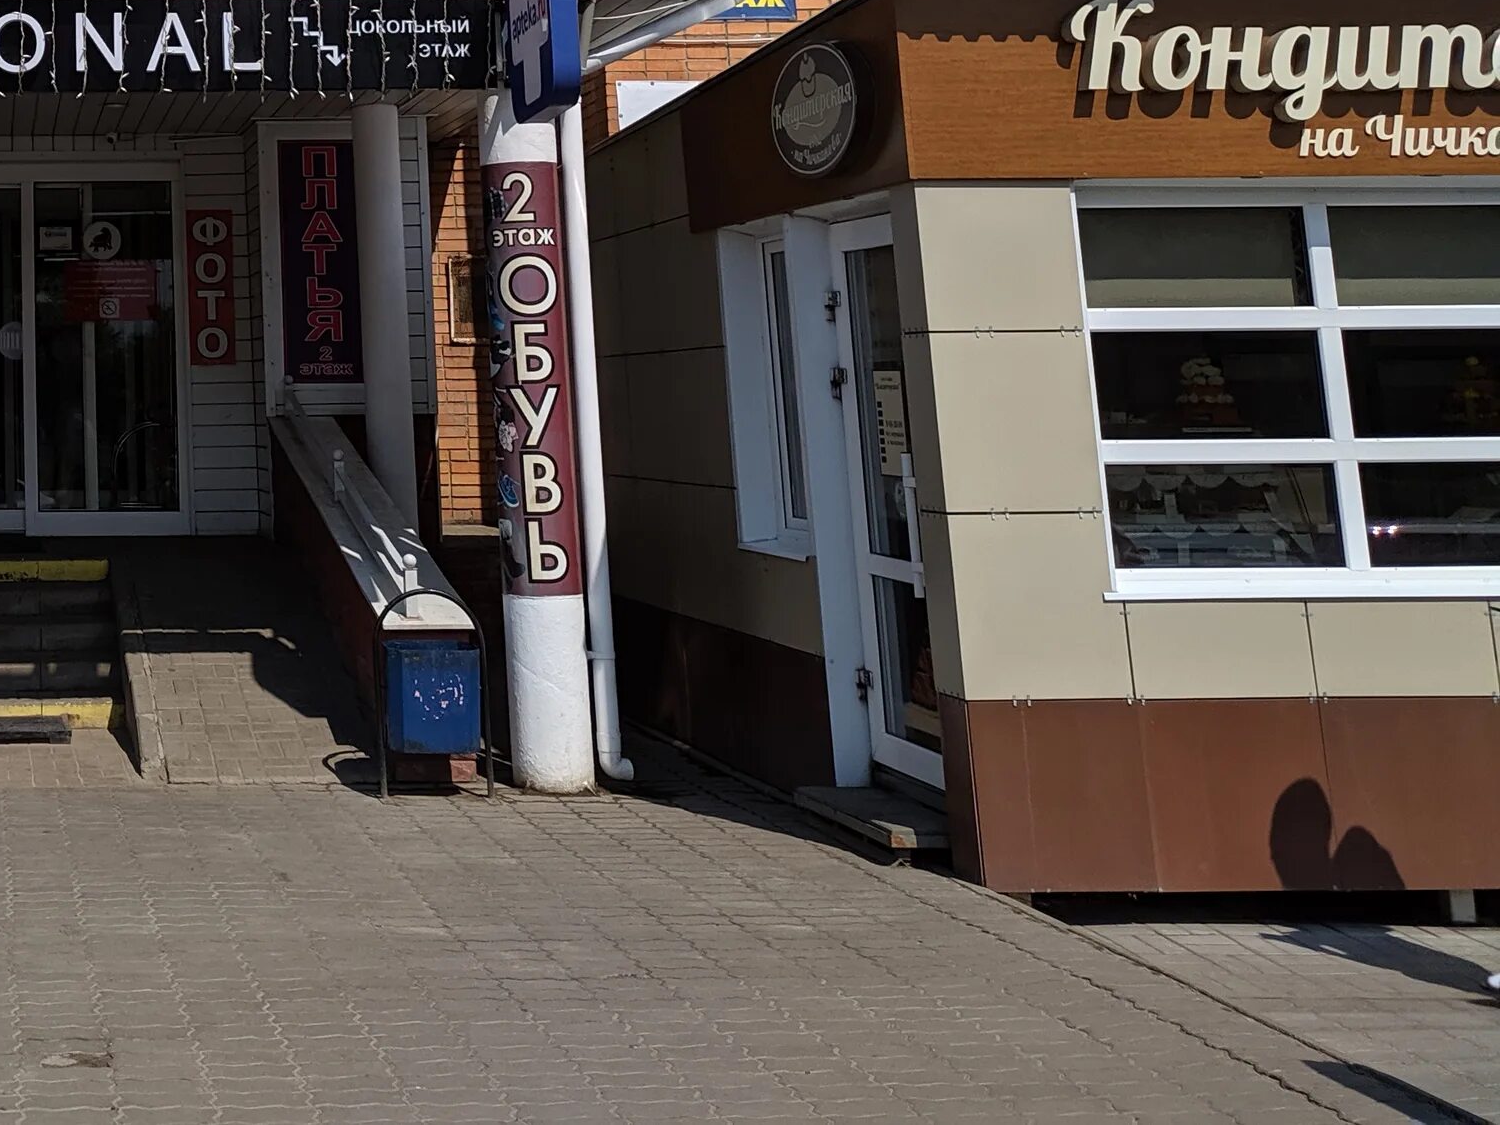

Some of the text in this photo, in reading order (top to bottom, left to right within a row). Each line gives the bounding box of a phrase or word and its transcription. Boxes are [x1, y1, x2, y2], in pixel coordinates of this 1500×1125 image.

[347, 15, 470, 38] ЦОКОЛЬНЫЙ
[418, 43, 471, 58] ЭТАЖ
[1300, 124, 1360, 157] на
[500, 171, 537, 224] 2
[300, 145, 344, 342] ПЛАТЬЯ
[492, 225, 556, 247] этаж
[192, 216, 229, 359] ФОТО
[318, 345, 333, 362] 2
[499, 253, 569, 584] ОБУВЬ
